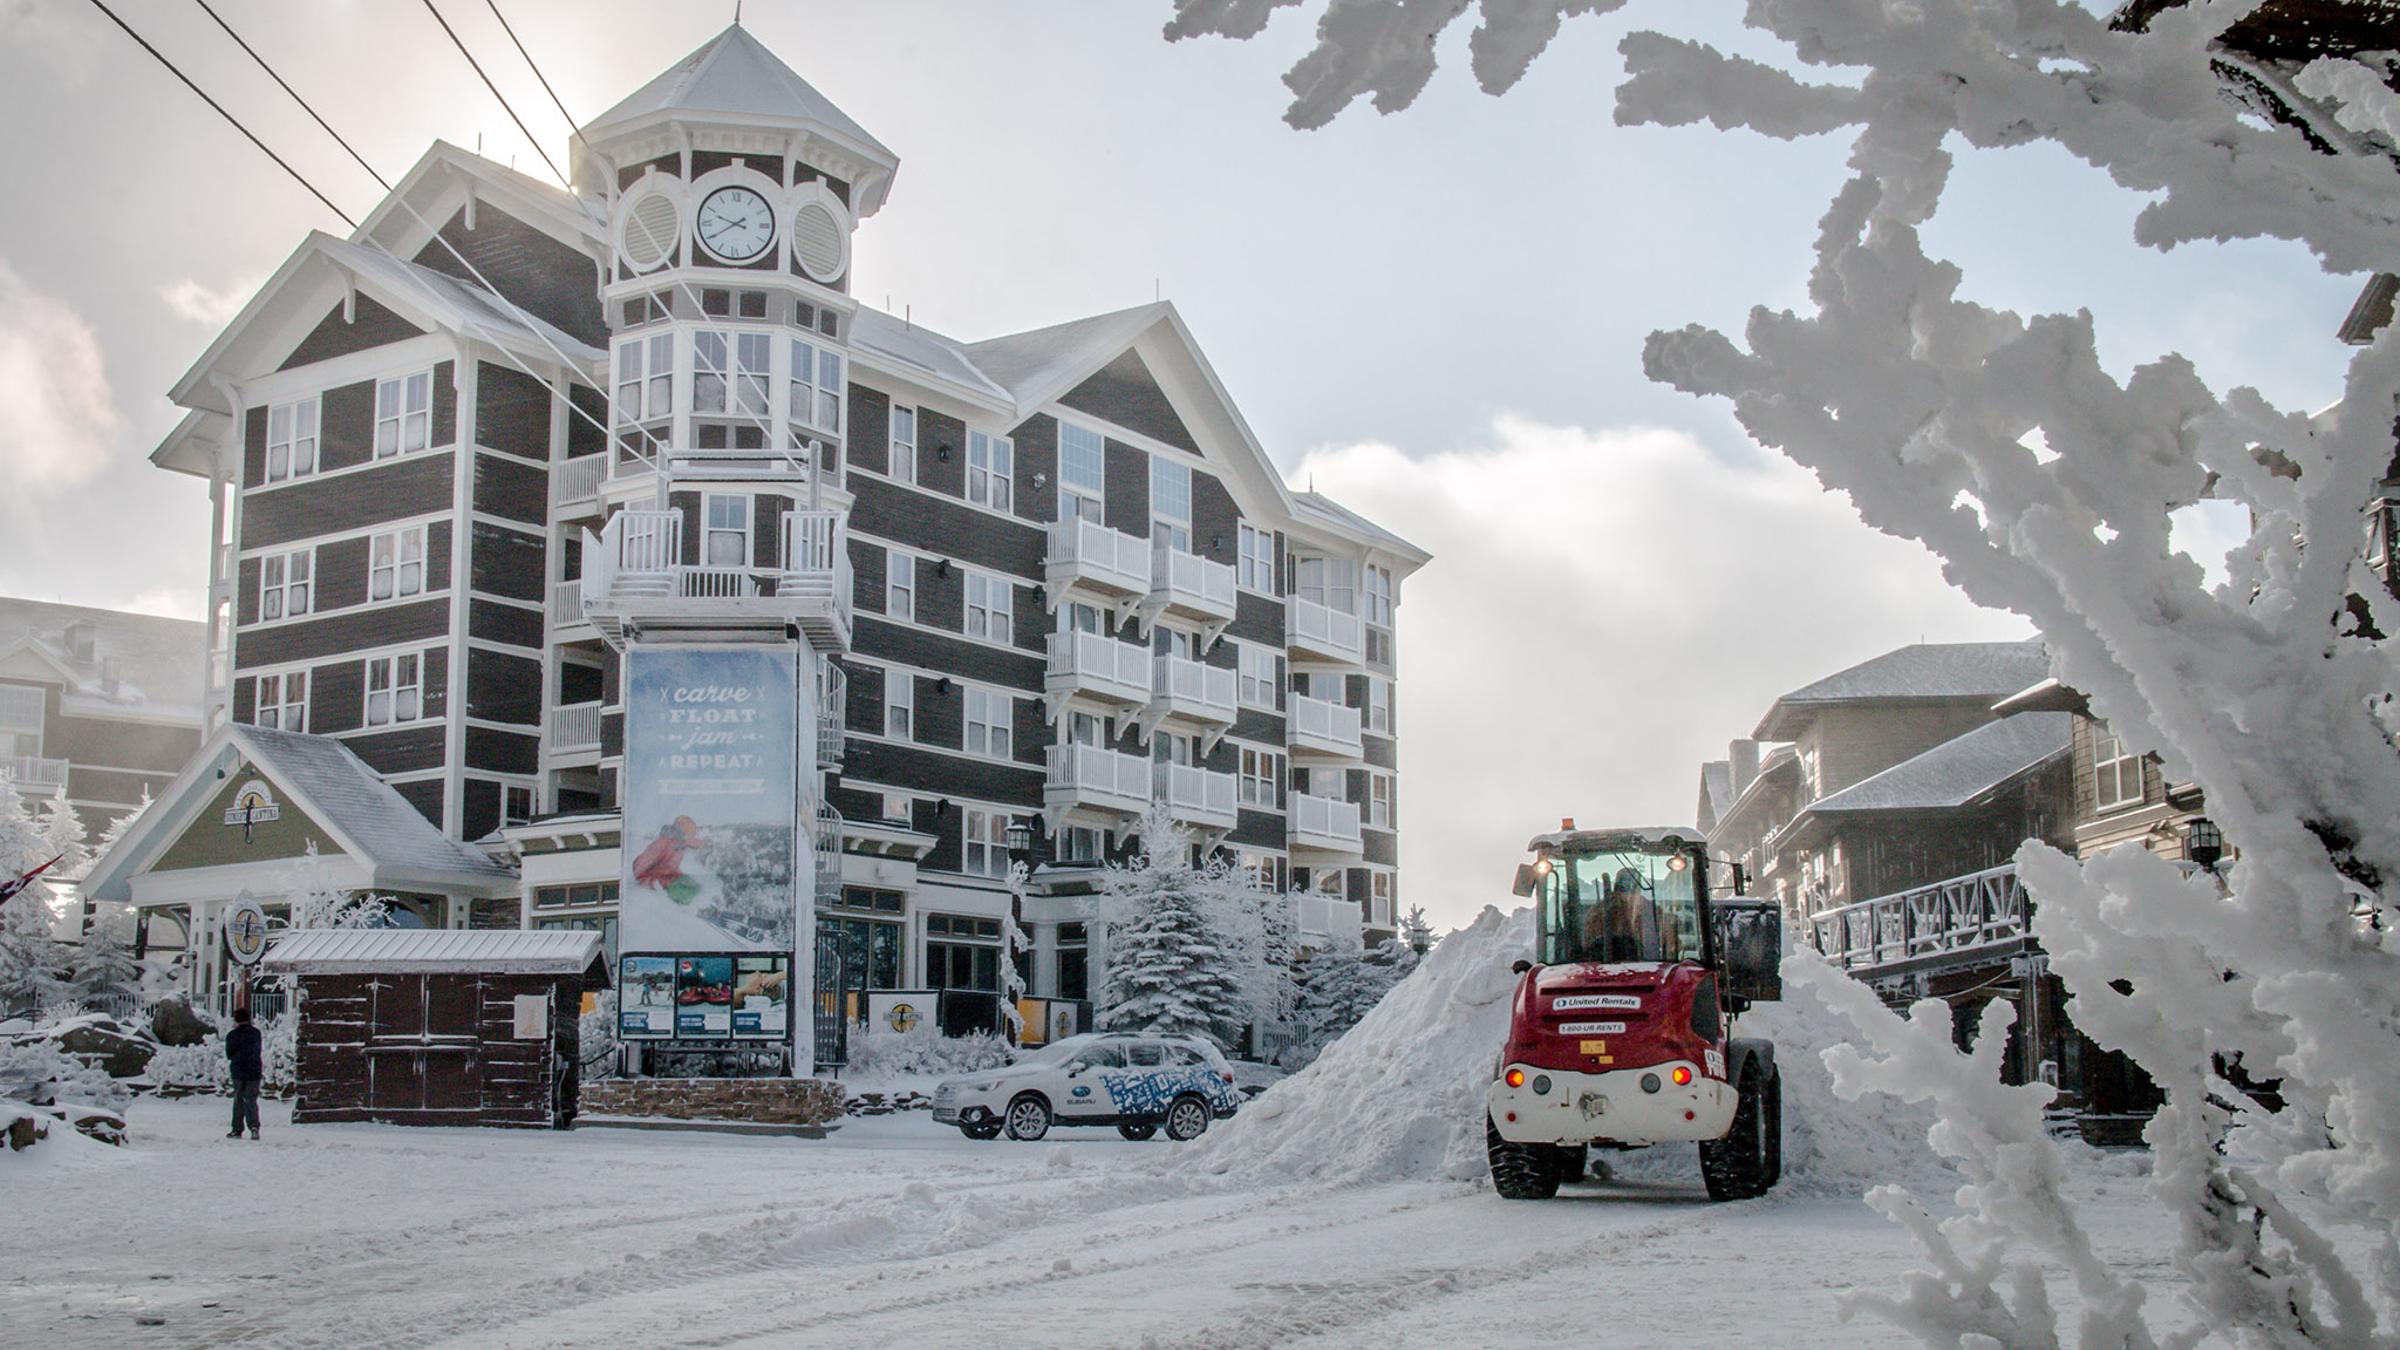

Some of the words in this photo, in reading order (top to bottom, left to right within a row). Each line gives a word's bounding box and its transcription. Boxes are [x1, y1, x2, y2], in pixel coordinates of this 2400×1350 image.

[674, 684, 752, 703] carve
[669, 708, 757, 723] FLOAT
[681, 726, 739, 750] jam
[671, 754, 753, 769] REPEAT
[1568, 998, 1600, 1006] United
[1601, 997, 1636, 1006] Rentals
[1561, 1024, 1623, 1032] 1-800-UR-RENTS
